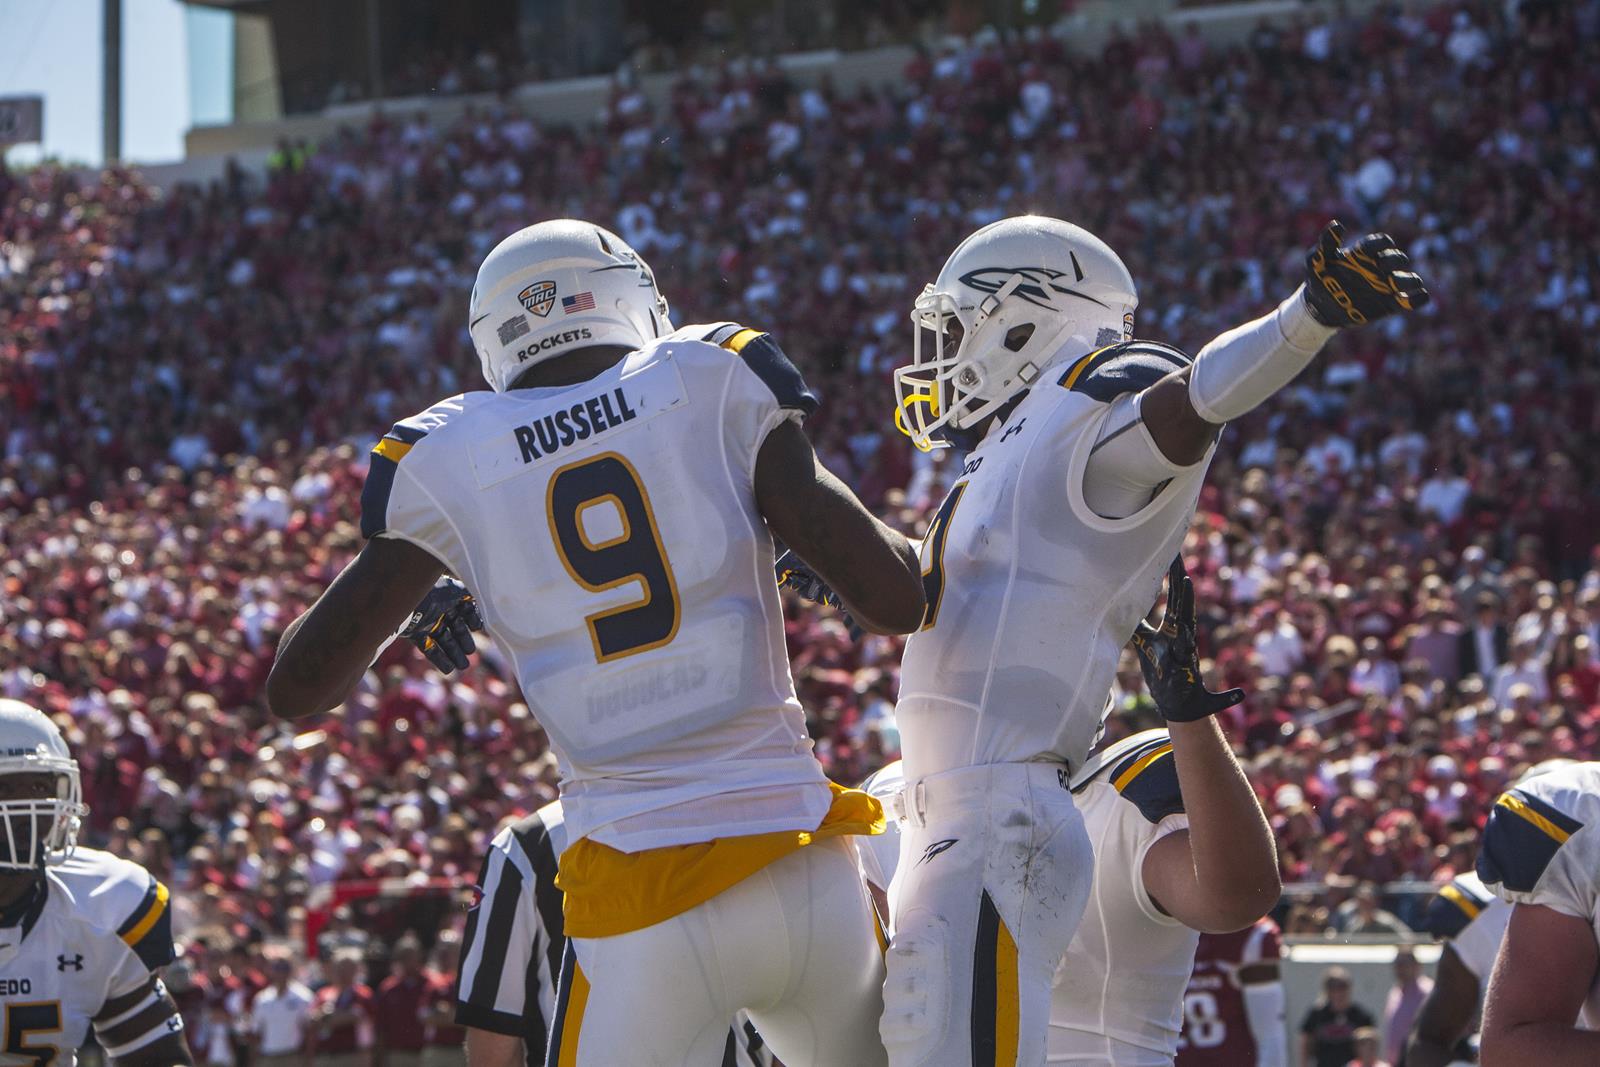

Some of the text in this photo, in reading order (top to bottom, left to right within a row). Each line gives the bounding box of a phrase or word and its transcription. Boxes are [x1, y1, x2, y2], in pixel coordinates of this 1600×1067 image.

[517, 328, 592, 362] ROCKETS
[513, 387, 637, 464] RUSSELL
[545, 450, 682, 665] 9
[2, 1000, 63, 1067] 5
